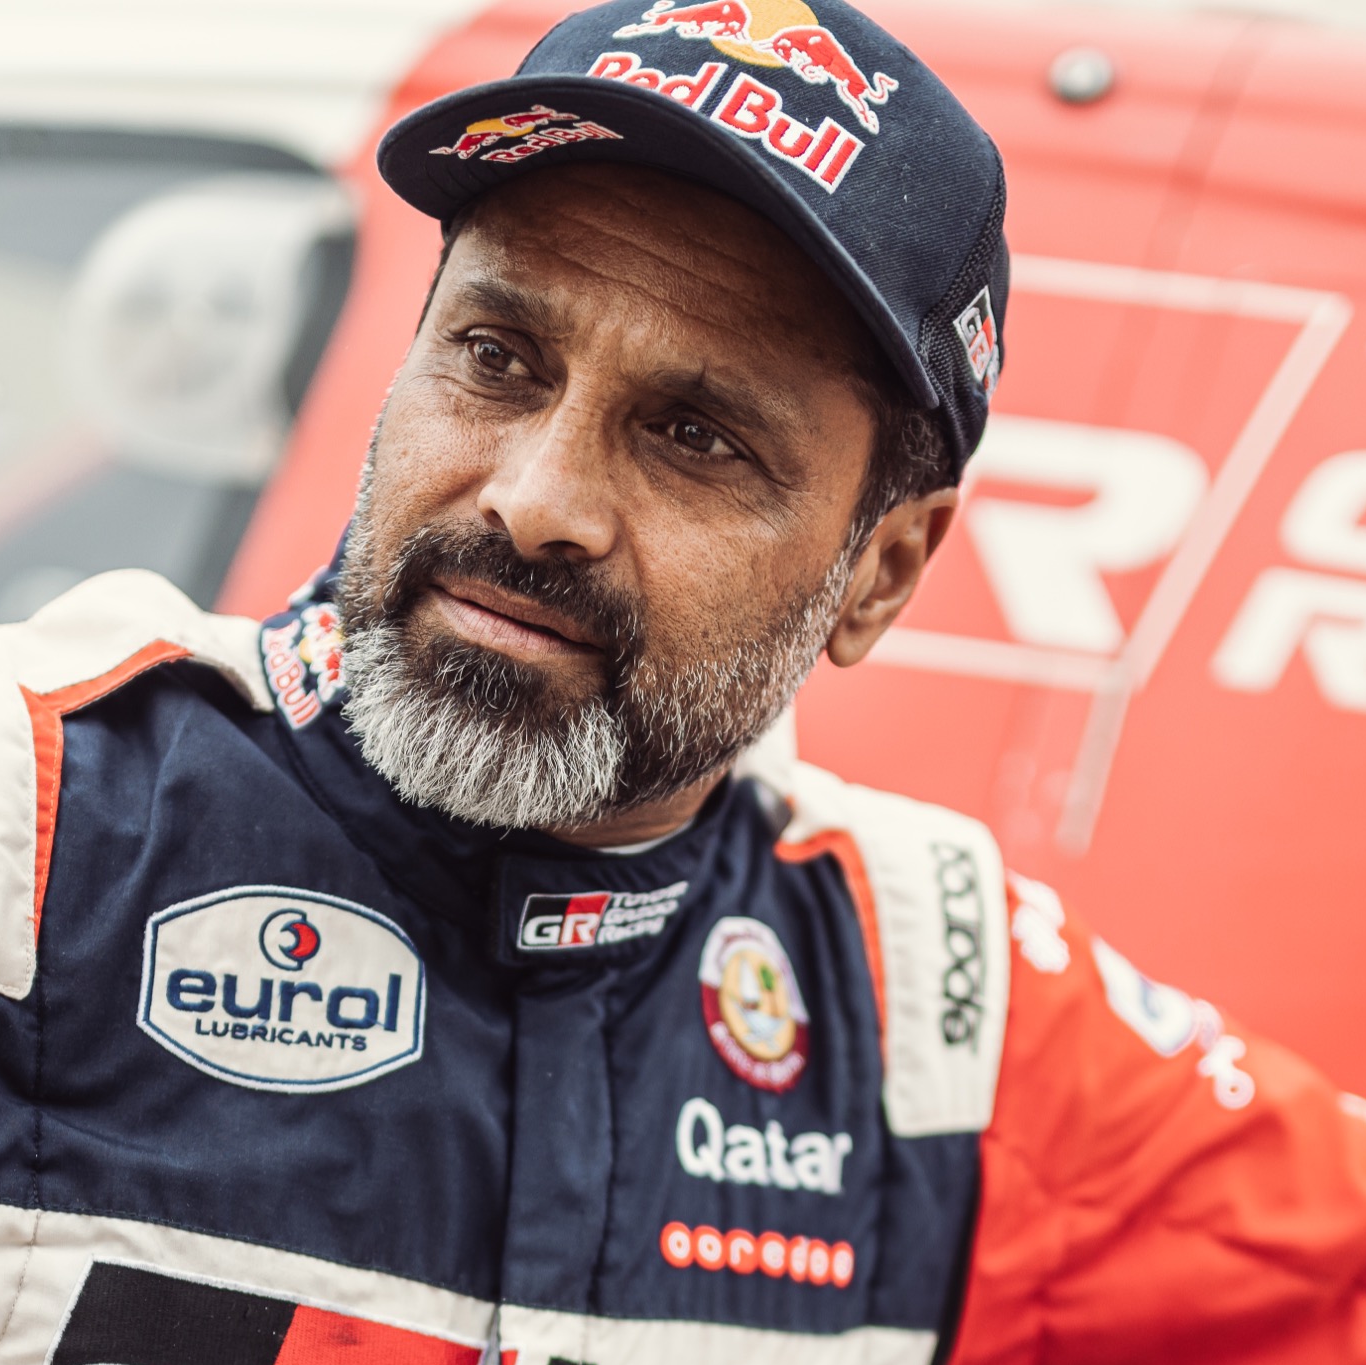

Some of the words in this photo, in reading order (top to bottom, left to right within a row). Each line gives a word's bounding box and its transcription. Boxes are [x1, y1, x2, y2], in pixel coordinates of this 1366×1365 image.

[481, 134, 567, 163] Red
[539, 121, 623, 142] Bull
[714, 72, 864, 194] Bull
[269, 652, 321, 730] Bull
[523, 914, 600, 945] GR
[166, 968, 402, 1032] eurol
[195, 1018, 368, 1052] LUBRICANTS
[676, 1097, 853, 1195] Qatar
